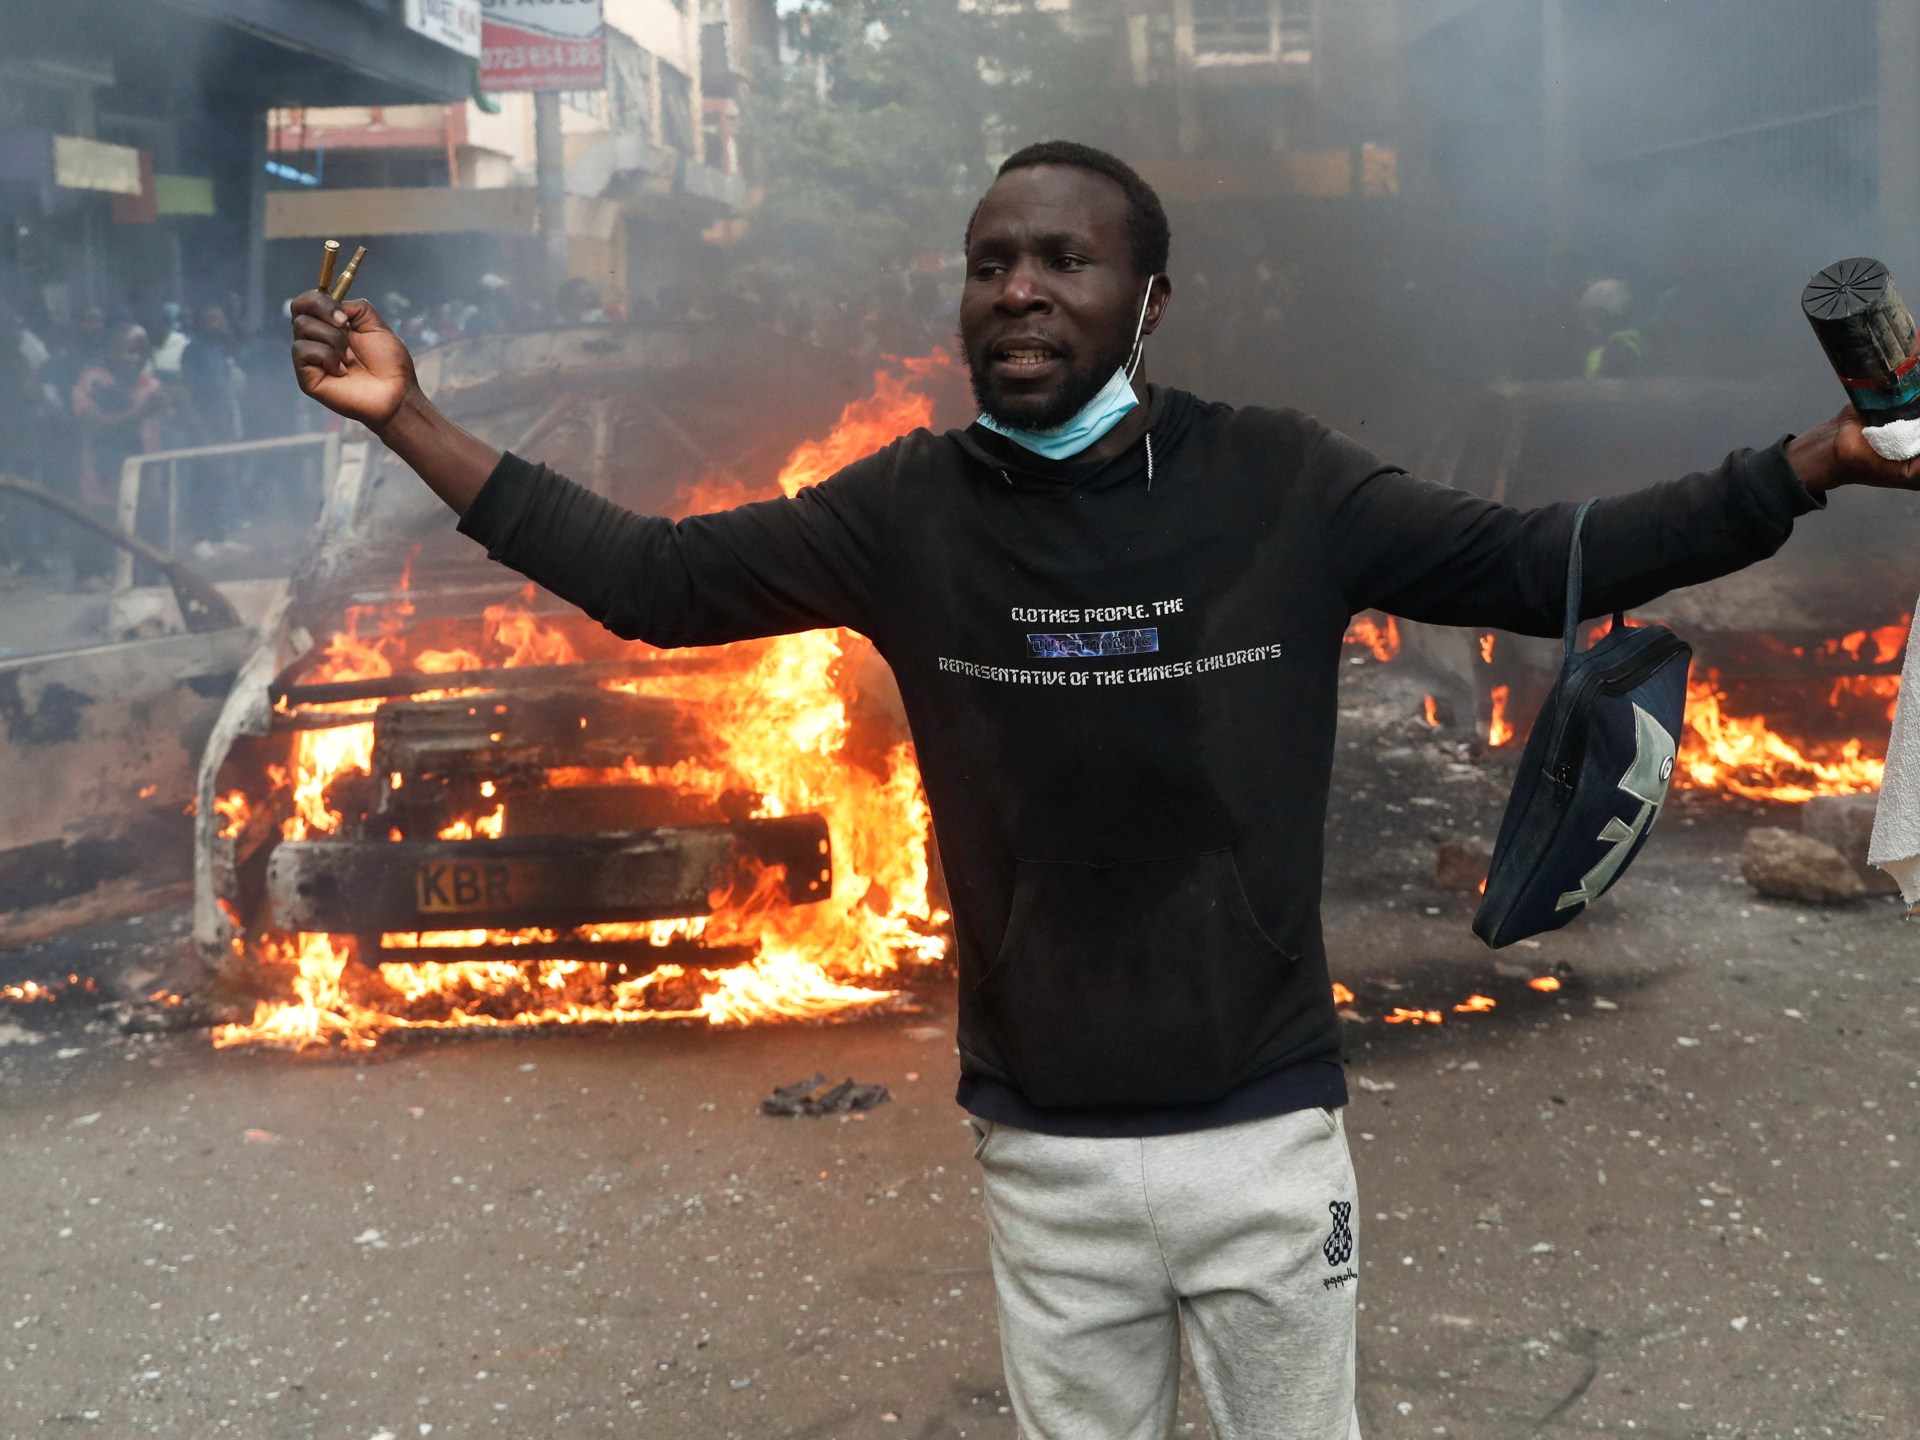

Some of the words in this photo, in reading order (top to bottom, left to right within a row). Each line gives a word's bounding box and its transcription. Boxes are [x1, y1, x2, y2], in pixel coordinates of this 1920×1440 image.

[1011, 607, 1080, 623] CLOTHES
[1084, 604, 1150, 623] PEOPLE.
[1152, 598, 1184, 616] THE
[938, 656, 1067, 686] REPRESENTATIVE
[1069, 671, 1090, 686] OF
[1093, 669, 1125, 686] THE
[1128, 661, 1193, 684] CHINESE
[1196, 644, 1282, 674] CHILDREN'S
